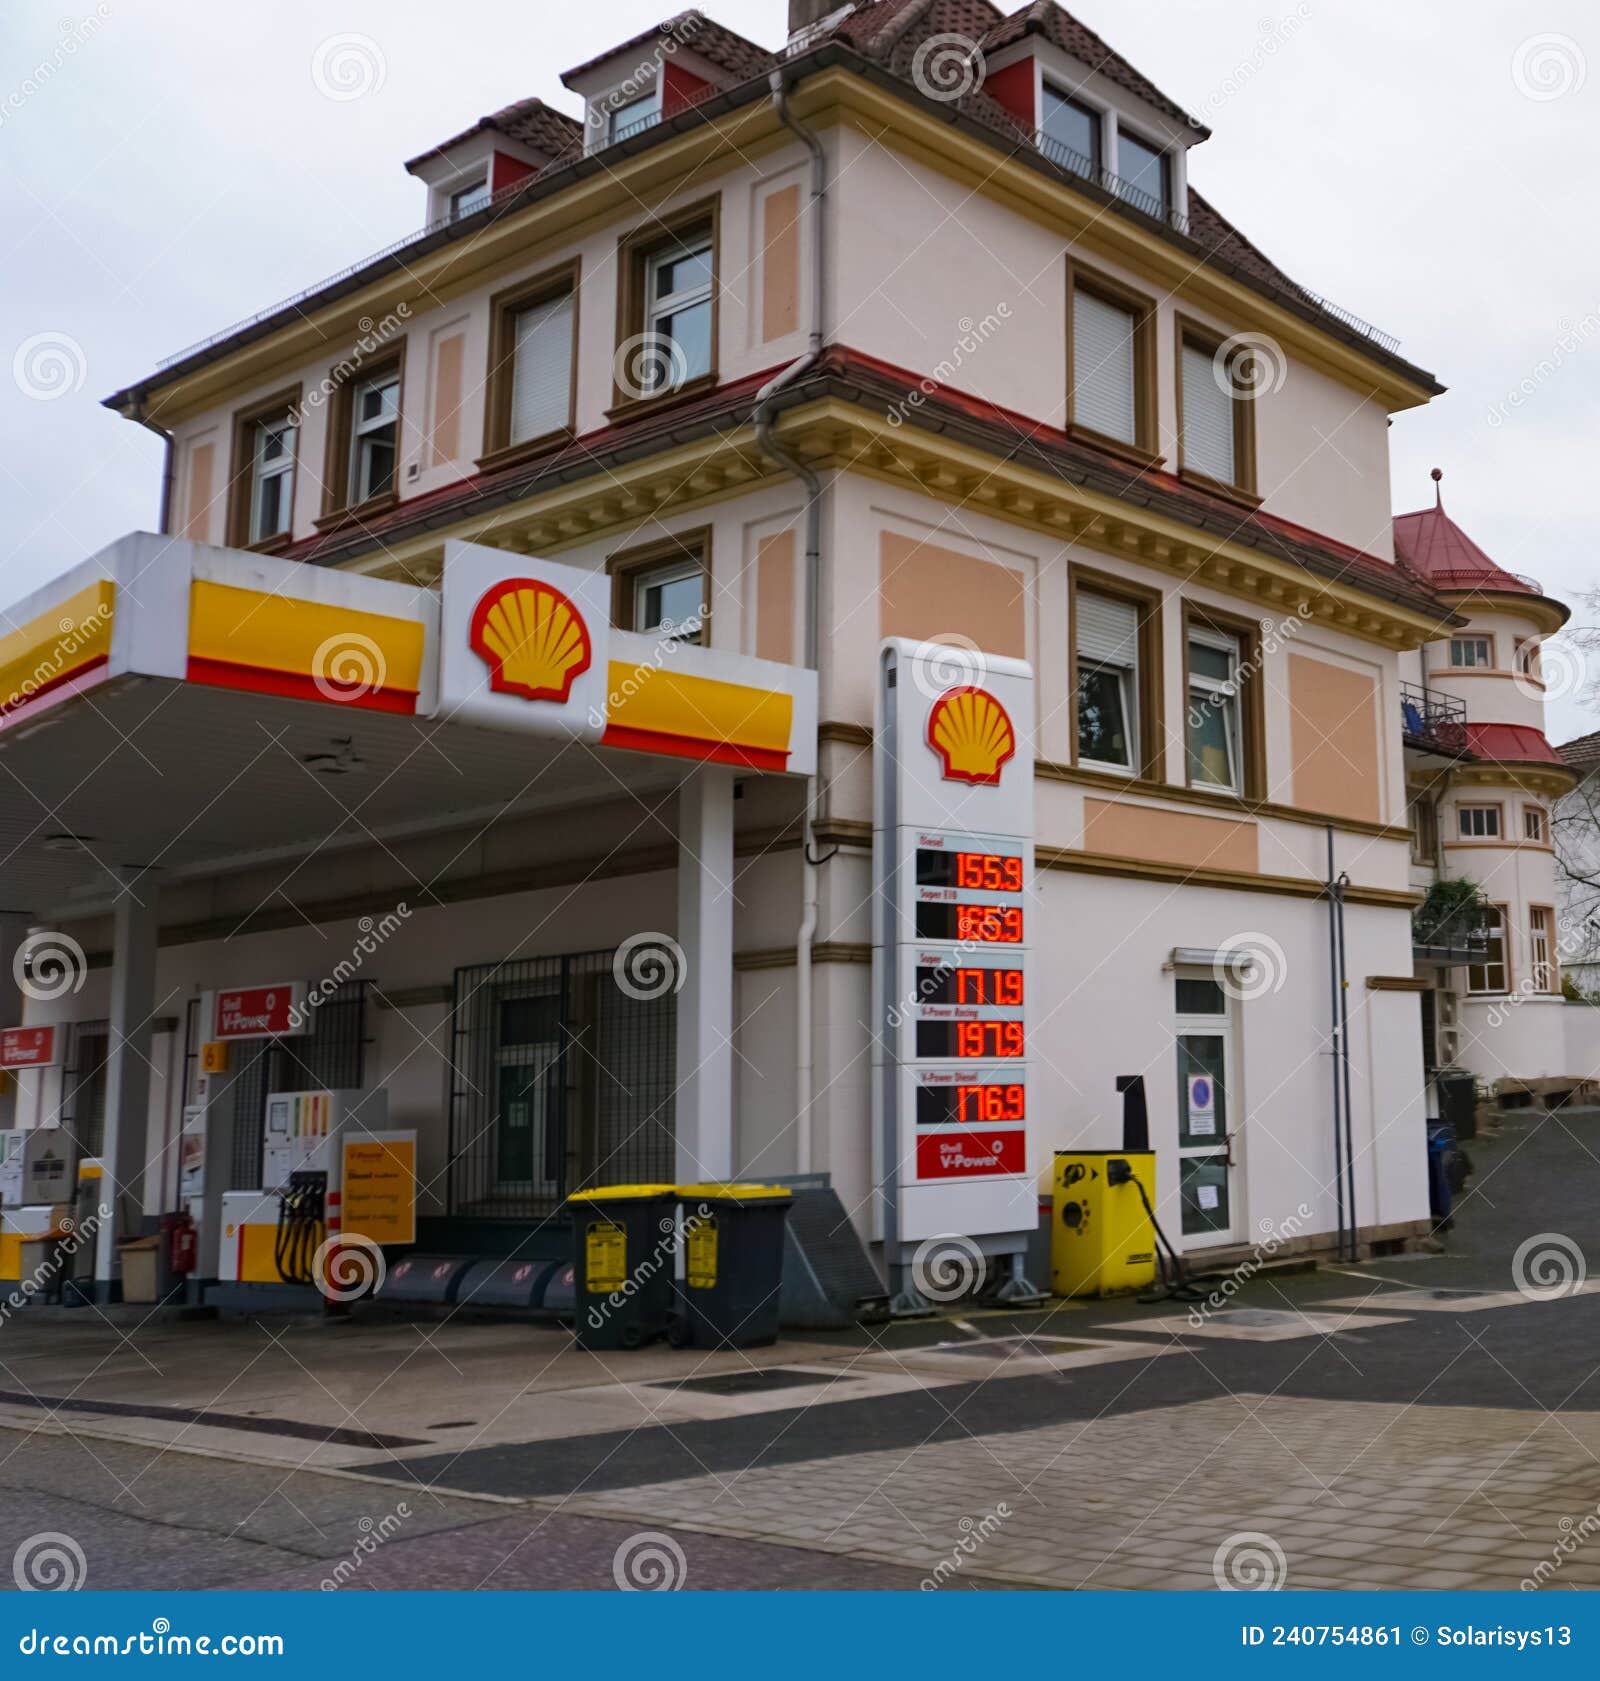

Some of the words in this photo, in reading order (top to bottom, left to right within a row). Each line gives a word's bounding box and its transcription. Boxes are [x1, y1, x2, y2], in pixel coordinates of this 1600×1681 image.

[920, 888, 942, 900] Super
[920, 953, 942, 964] Super
[921, 1007, 952, 1017] V-Power
[954, 1008, 978, 1019] Racing
[222, 1012, 272, 1030] V-Power
[205, 1048, 215, 1067] 6
[921, 1072, 953, 1082] V-Power
[954, 1072, 978, 1082] Diesel
[939, 1143, 963, 1154] Shell
[940, 1154, 999, 1169] V-Power
